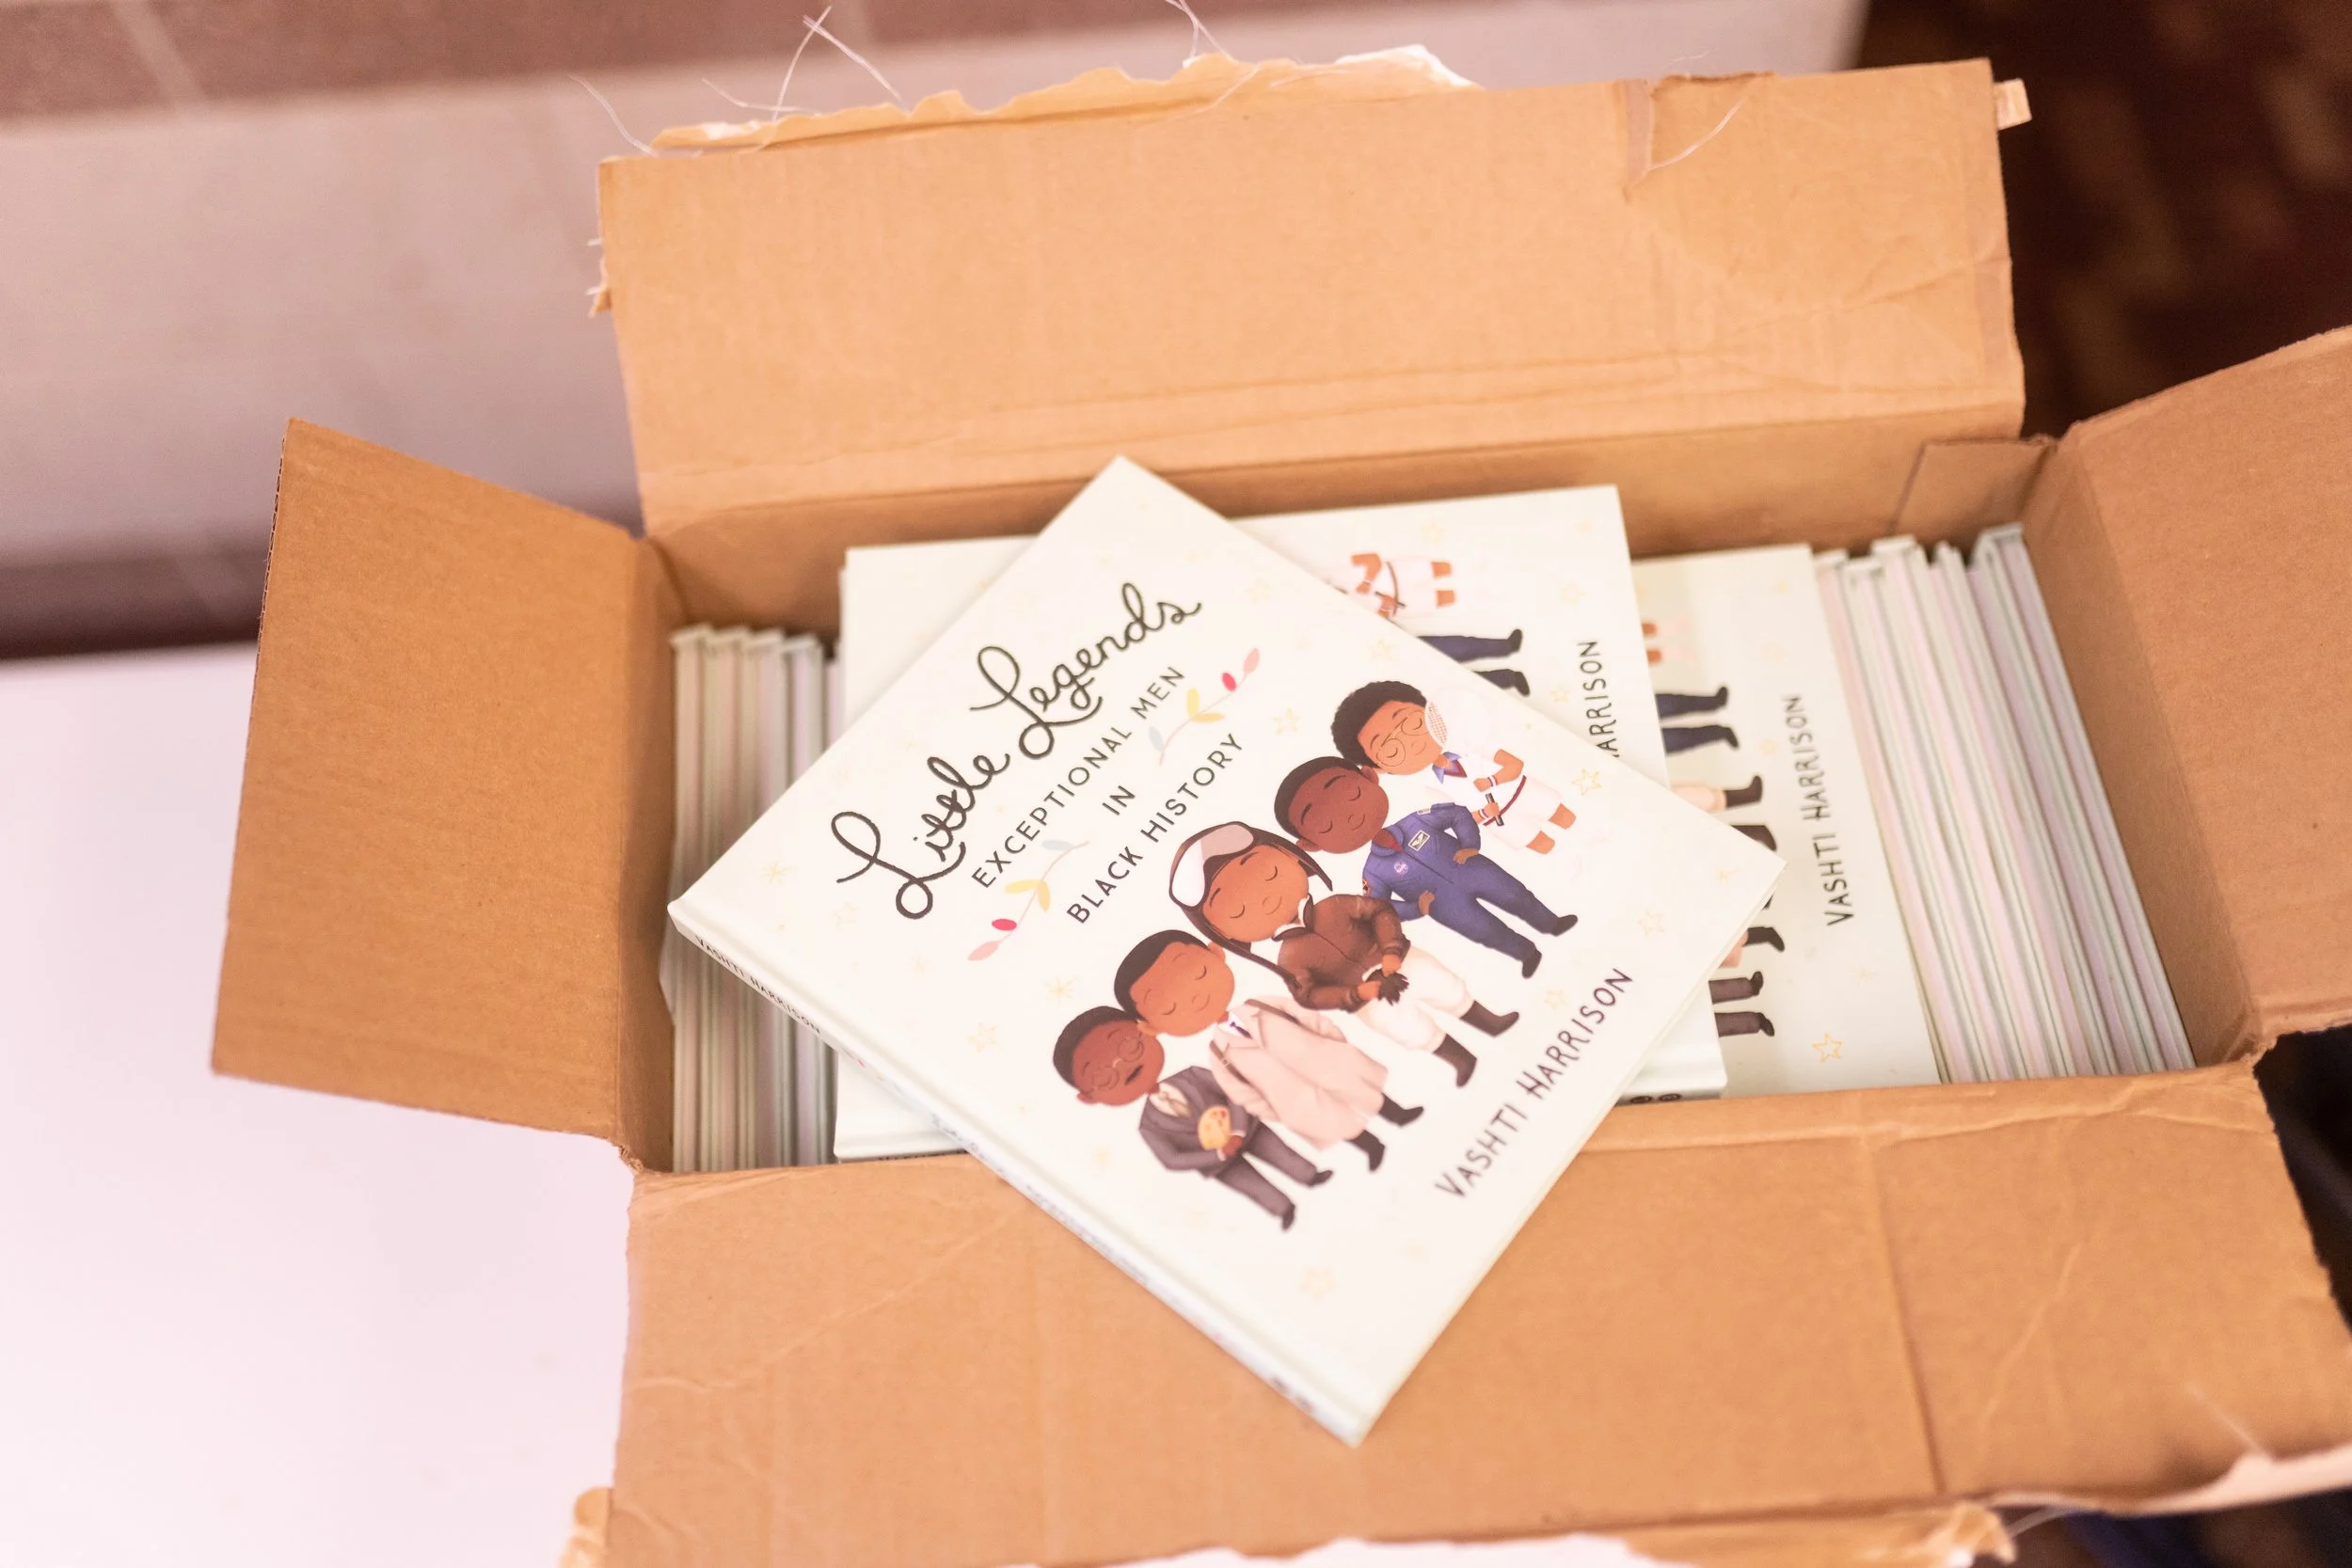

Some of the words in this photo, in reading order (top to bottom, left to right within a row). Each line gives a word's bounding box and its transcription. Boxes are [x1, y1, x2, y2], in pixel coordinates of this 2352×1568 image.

[830, 751, 1011, 920] Little
[968, 581, 1203, 761] Legends
[971, 726, 1133, 889] EXCEPTIONAL
[1131, 666, 1185, 721] MEN
[1576, 640, 1621, 758] ARRISON
[1781, 692, 1832, 821] HARRISON
[1066, 846, 1144, 925] BLACK
[1139, 733, 1244, 844] HISTORY
[1102, 784, 1136, 816] IN
[1812, 832, 1855, 927] VASHTI
[1434, 1102, 1529, 1198] VASHTI
[1515, 968, 1634, 1100] HARRISON
